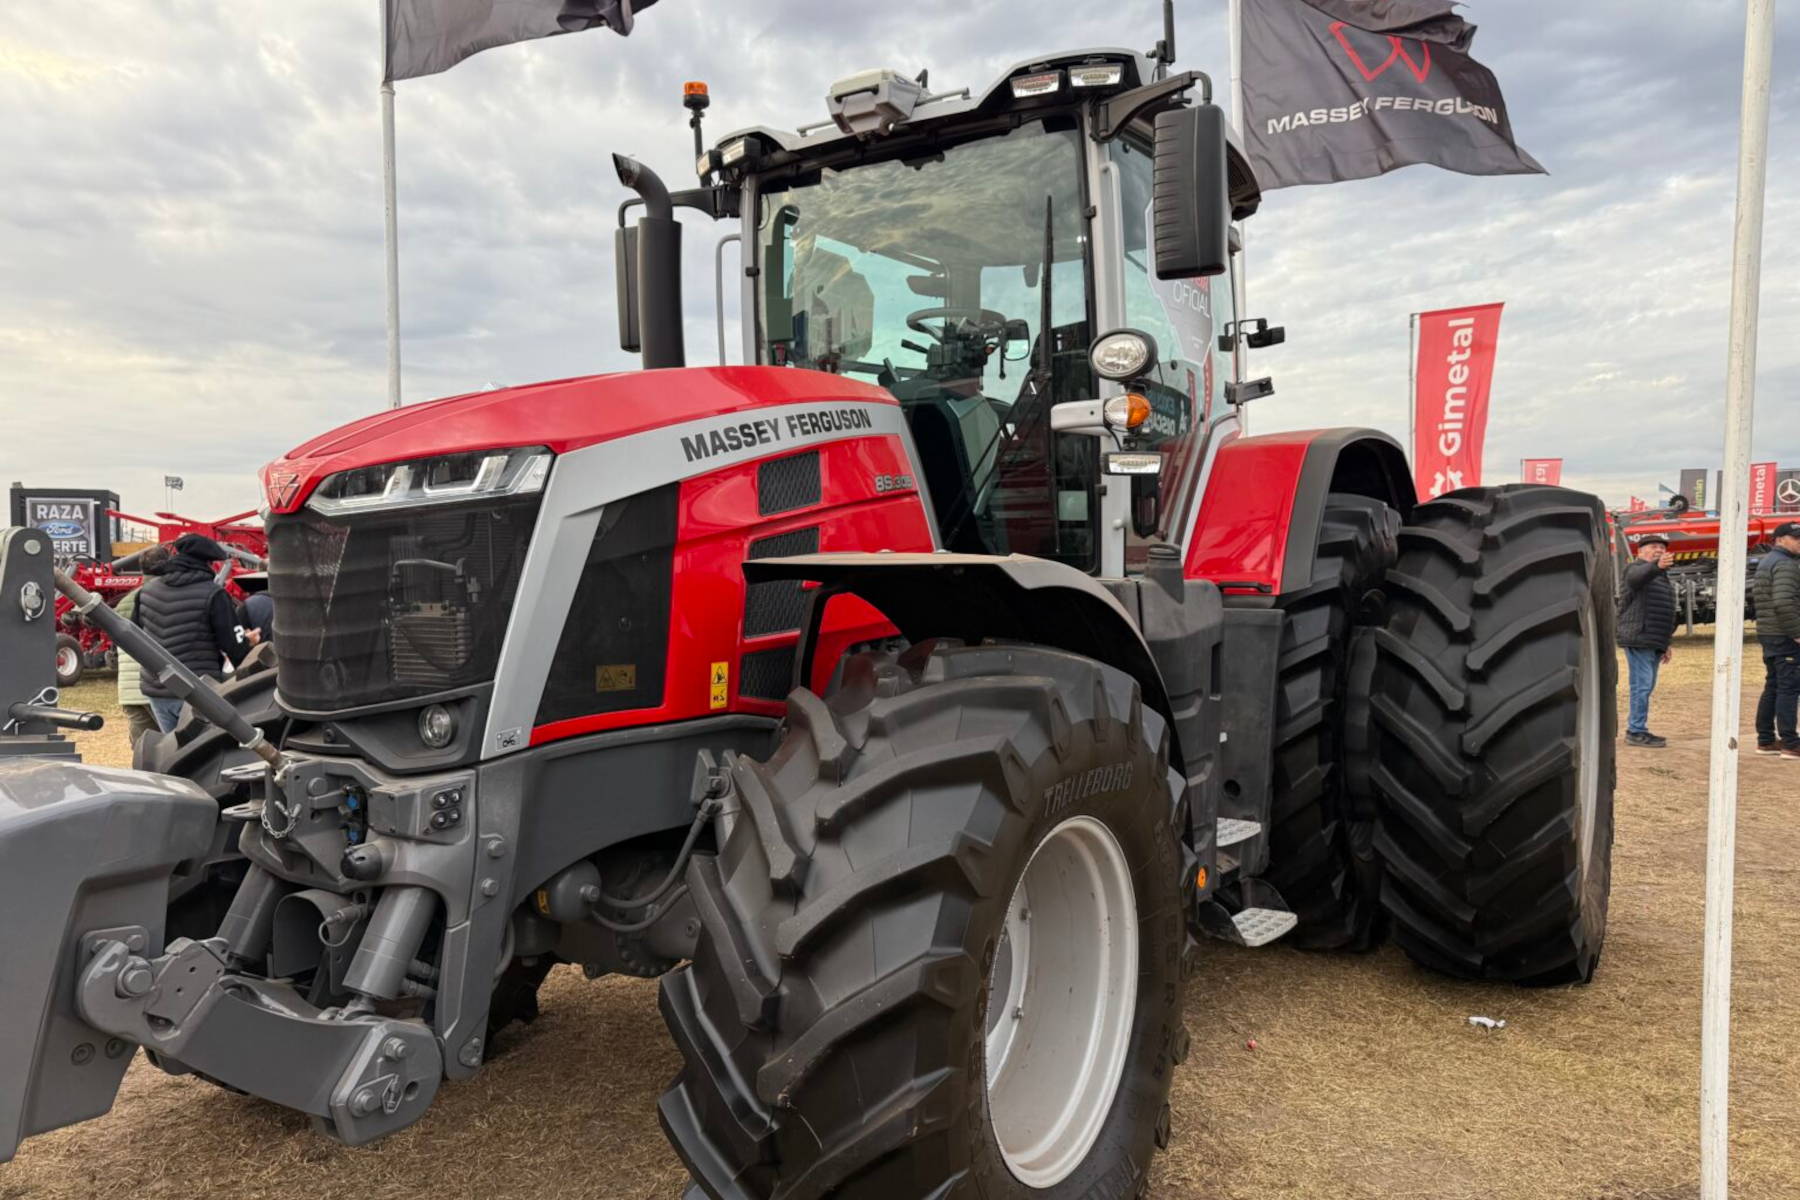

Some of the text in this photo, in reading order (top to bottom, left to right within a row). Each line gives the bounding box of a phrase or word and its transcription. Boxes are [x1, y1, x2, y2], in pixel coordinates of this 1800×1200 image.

[1267, 98, 1370, 134] MASSEY
[1438, 317, 1475, 456] Gimetal
[680, 408, 872, 462] MASSEY FERGUSON
[36, 504, 84, 520] RAZA
[46, 522, 73, 535] Ford
[1043, 761, 1134, 817] TRELLEBORG
